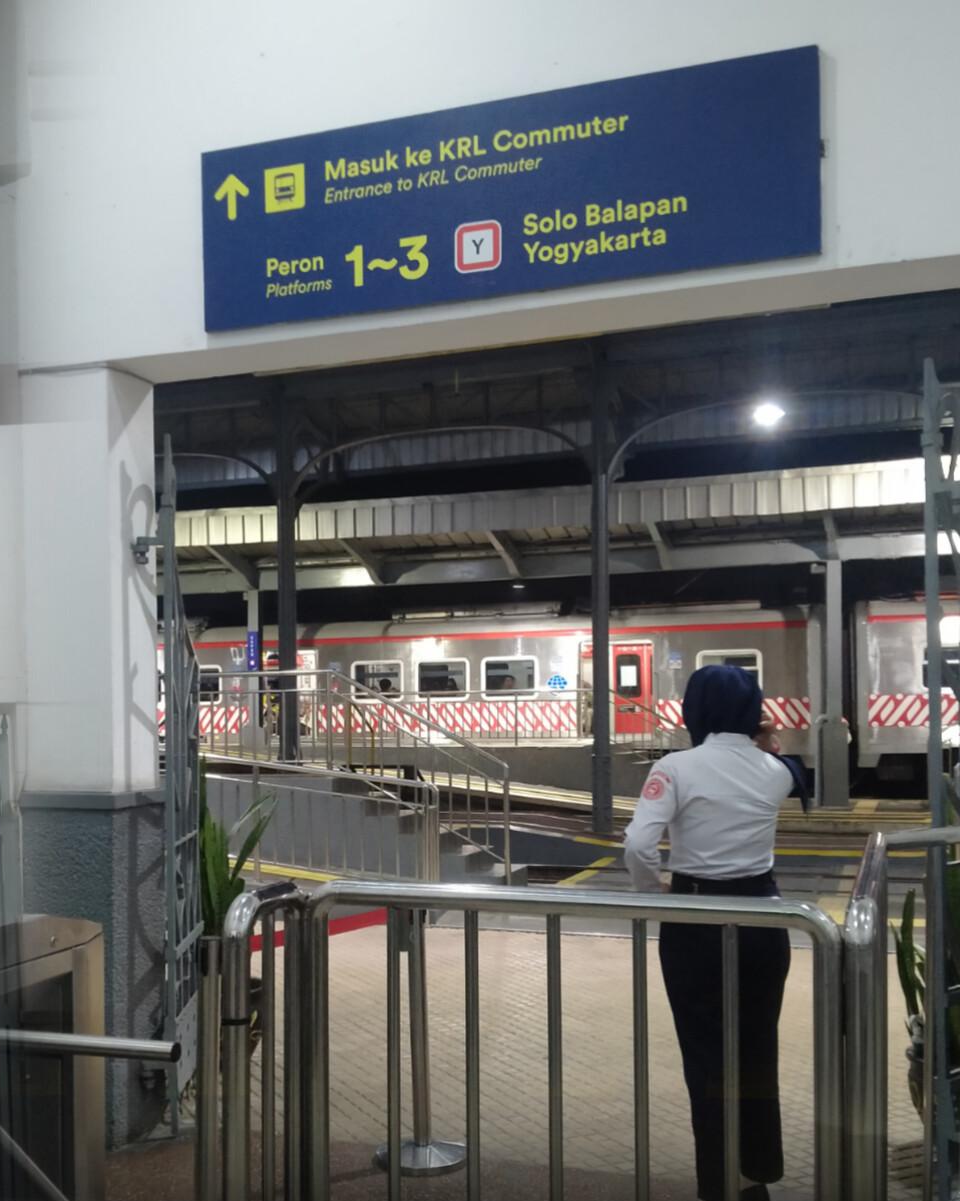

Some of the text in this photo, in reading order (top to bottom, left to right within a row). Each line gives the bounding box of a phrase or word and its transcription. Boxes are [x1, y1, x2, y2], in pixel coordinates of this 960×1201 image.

[325, 116, 628, 182] Masuk ke KRL Commuter
[325, 154, 542, 204] Entrance to KRL Commuter
[524, 197, 687, 235] Solo Balapan
[345, 235, 428, 286] 1~3
[472, 236, 484, 256] Y
[524, 226, 666, 264] Yogyakarta
[267, 256, 324, 277] Peron
[266, 275, 332, 298] Platforms
